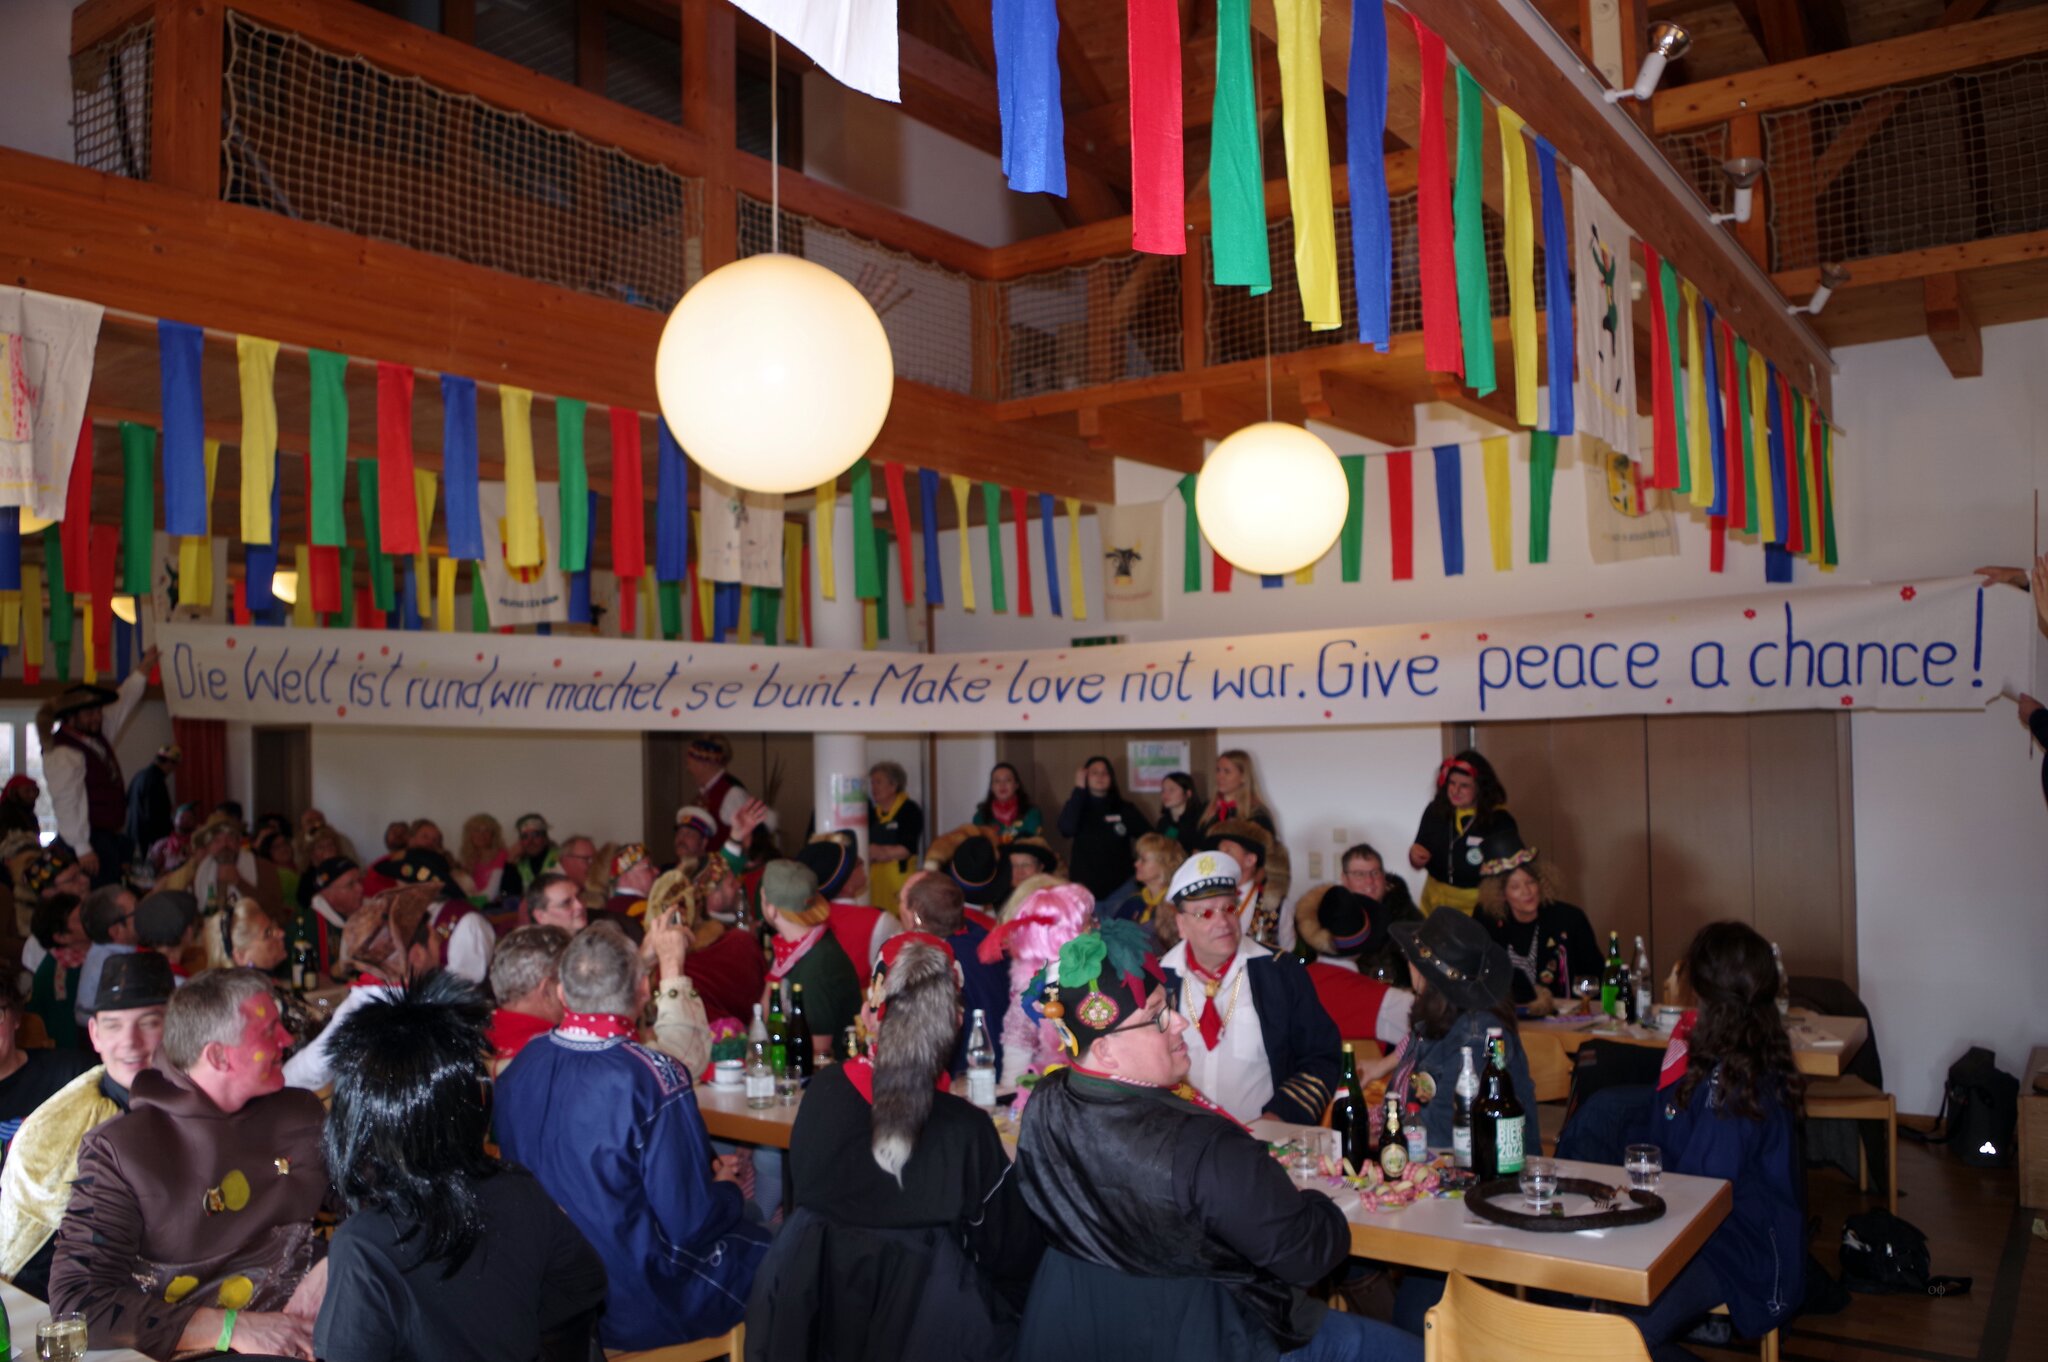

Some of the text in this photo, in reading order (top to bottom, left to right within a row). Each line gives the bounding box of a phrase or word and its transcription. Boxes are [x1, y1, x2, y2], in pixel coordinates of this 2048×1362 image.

[174, 642, 228, 700] Die
[244, 646, 339, 704] Welt
[349, 652, 404, 708] ist
[752, 661, 861, 708] bunt.
[869, 663, 992, 706] Make
[1120, 651, 1196, 702] not
[1212, 663, 1306, 700] war.
[1317, 639, 1440, 699] Give
[1478, 643, 1660, 712] peace
[1690, 641, 1730, 689] a
[1748, 586, 1984, 689] chance!
